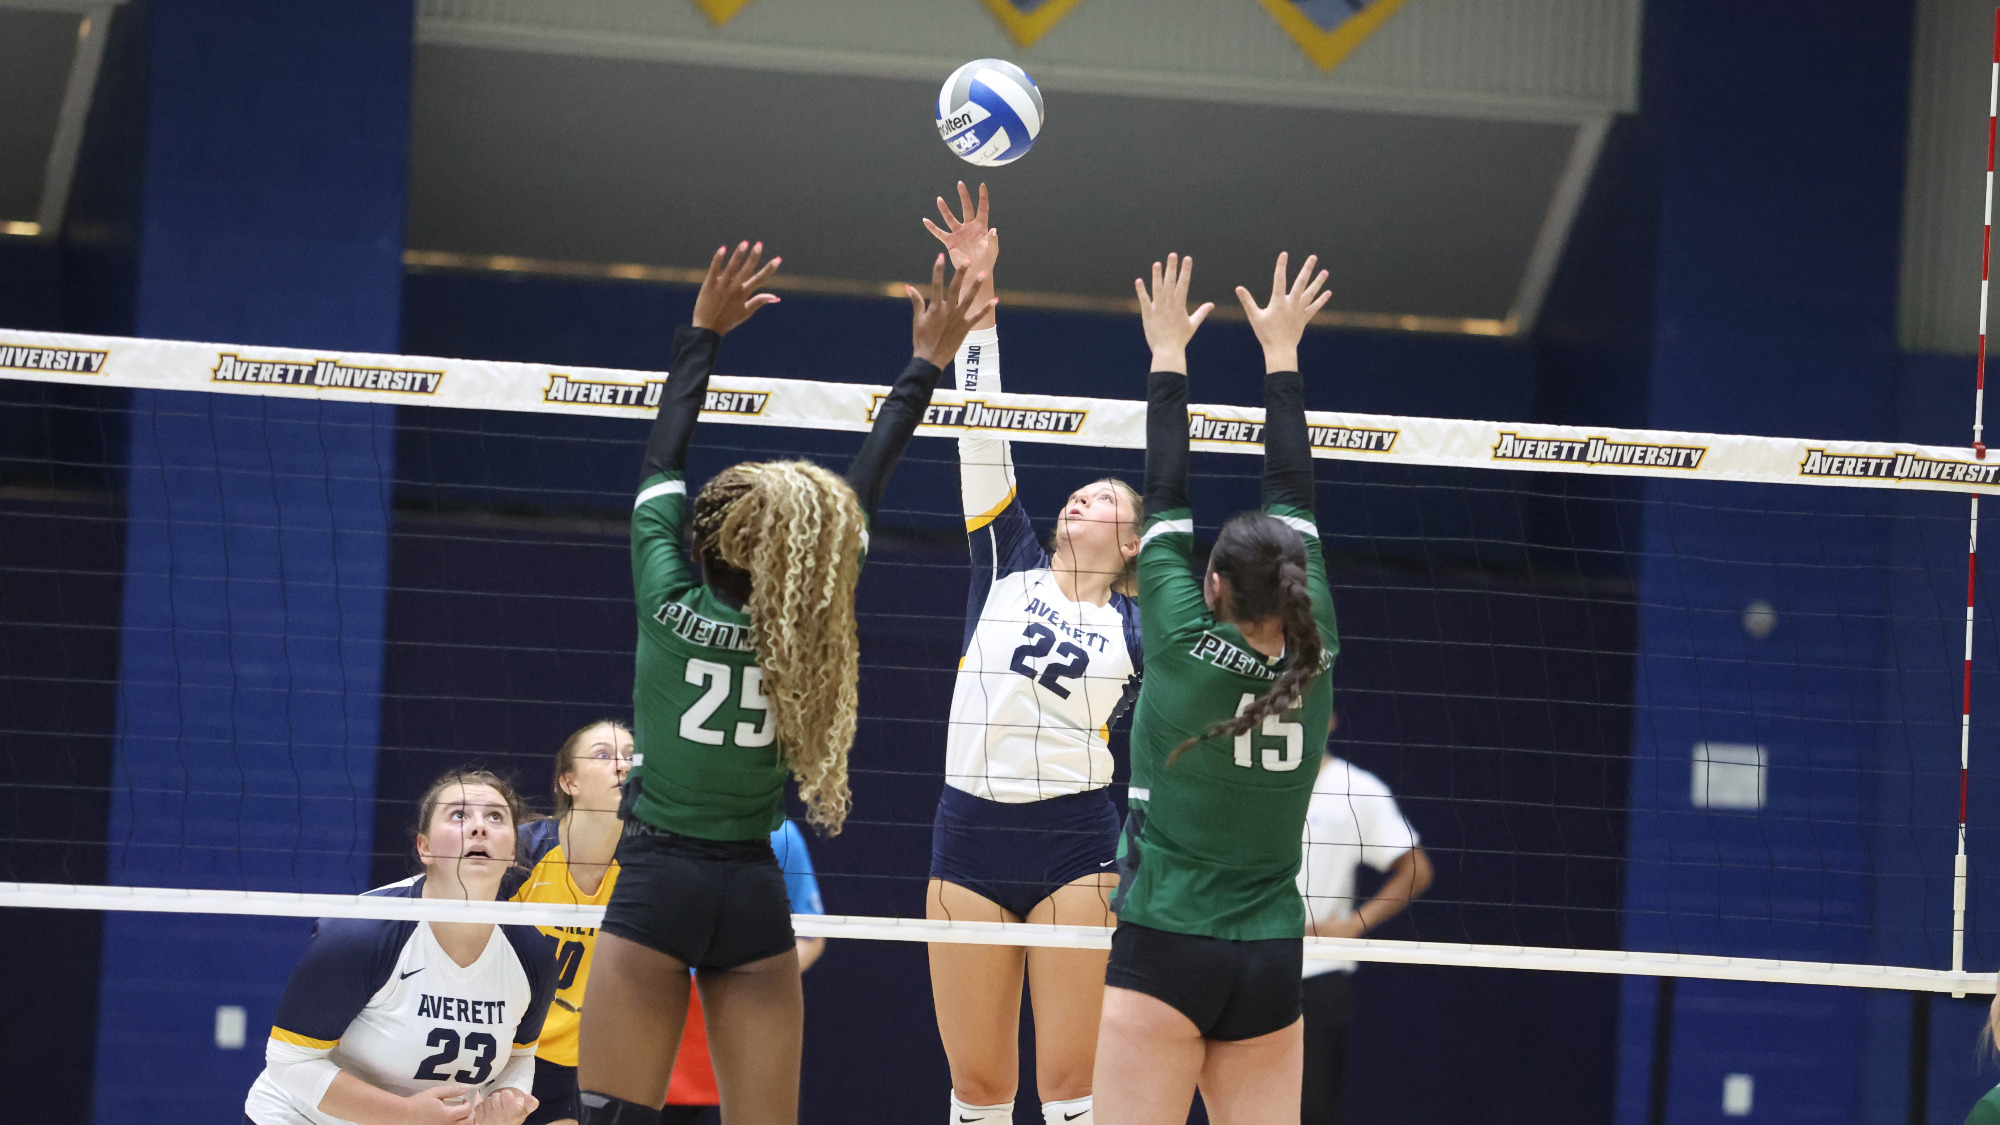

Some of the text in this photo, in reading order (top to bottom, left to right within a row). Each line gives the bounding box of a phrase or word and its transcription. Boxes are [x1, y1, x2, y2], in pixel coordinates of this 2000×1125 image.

[0, 346, 106, 372] IVERSITY
[215, 355, 440, 392] AVERETT UNIVERSITY
[965, 345, 981, 391] ONE TEA
[547, 376, 767, 414] AVERETT URSITY
[963, 402, 1086, 432] UNIVERSITY
[1189, 415, 1396, 451] AVERET IVERSITY
[1495, 434, 1703, 467] AVERETT UNIVERSITY
[1803, 450, 2000, 483] AVERETT UNIVERSIT
[653, 600, 758, 651] PIED
[1024, 597, 1110, 653] AVERETT
[1009, 621, 1090, 700] 22
[679, 657, 776, 748] 25
[1233, 692, 1304, 772] 15
[417, 993, 505, 1025] AVERETT
[413, 1027, 497, 1085] 23
